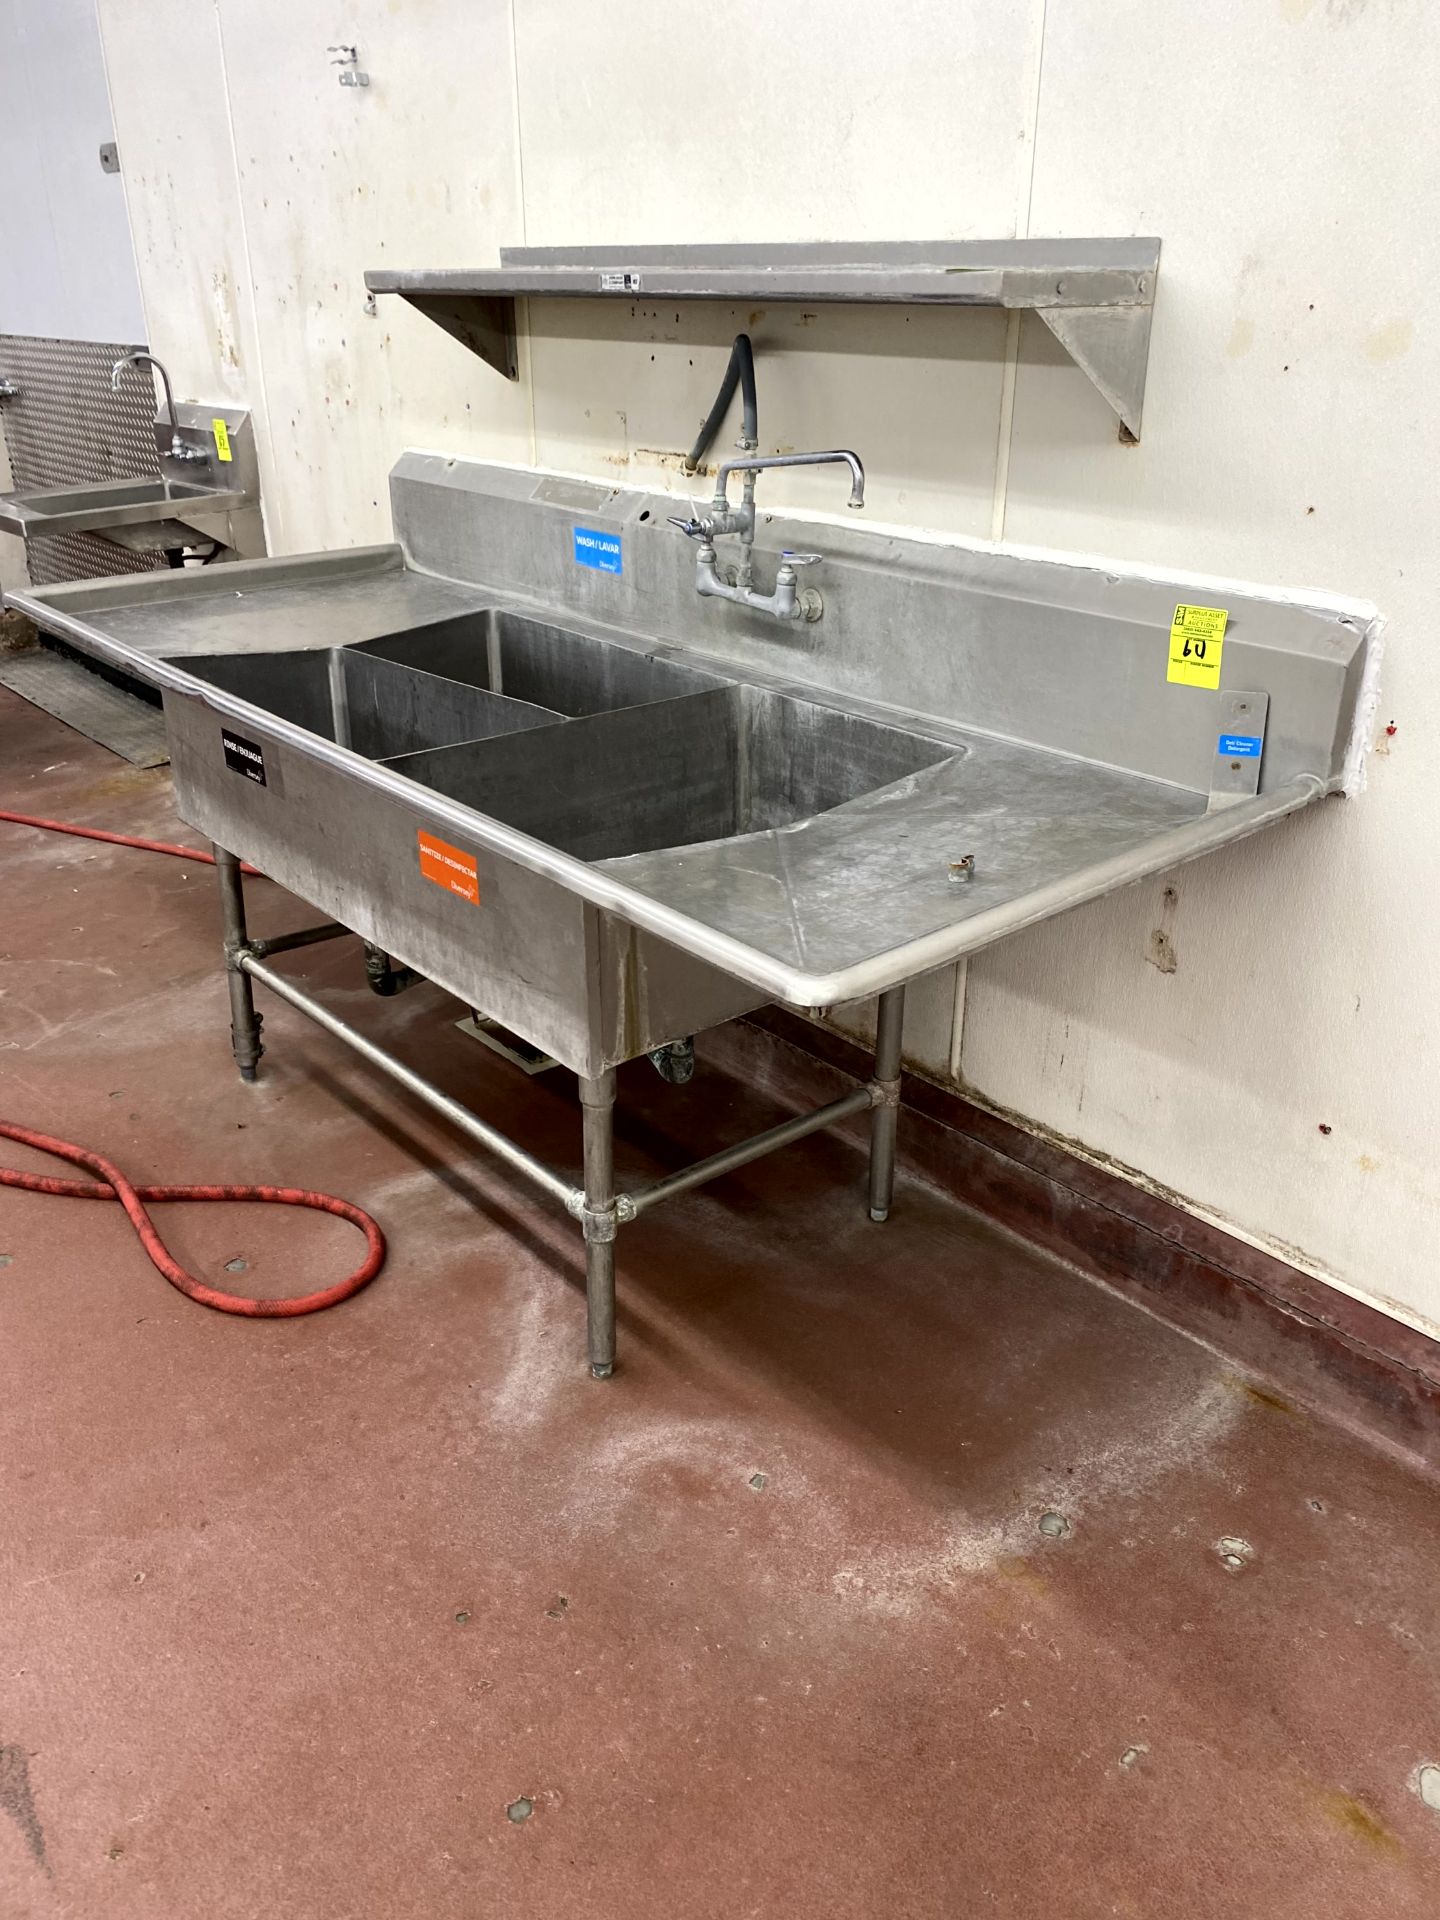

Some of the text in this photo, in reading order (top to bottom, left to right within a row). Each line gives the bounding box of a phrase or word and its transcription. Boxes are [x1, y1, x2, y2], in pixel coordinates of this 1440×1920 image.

[576, 535, 595, 549] WASH
[599, 540, 620, 555] LAVAR
[1188, 620, 1219, 630] AUCTIONS
